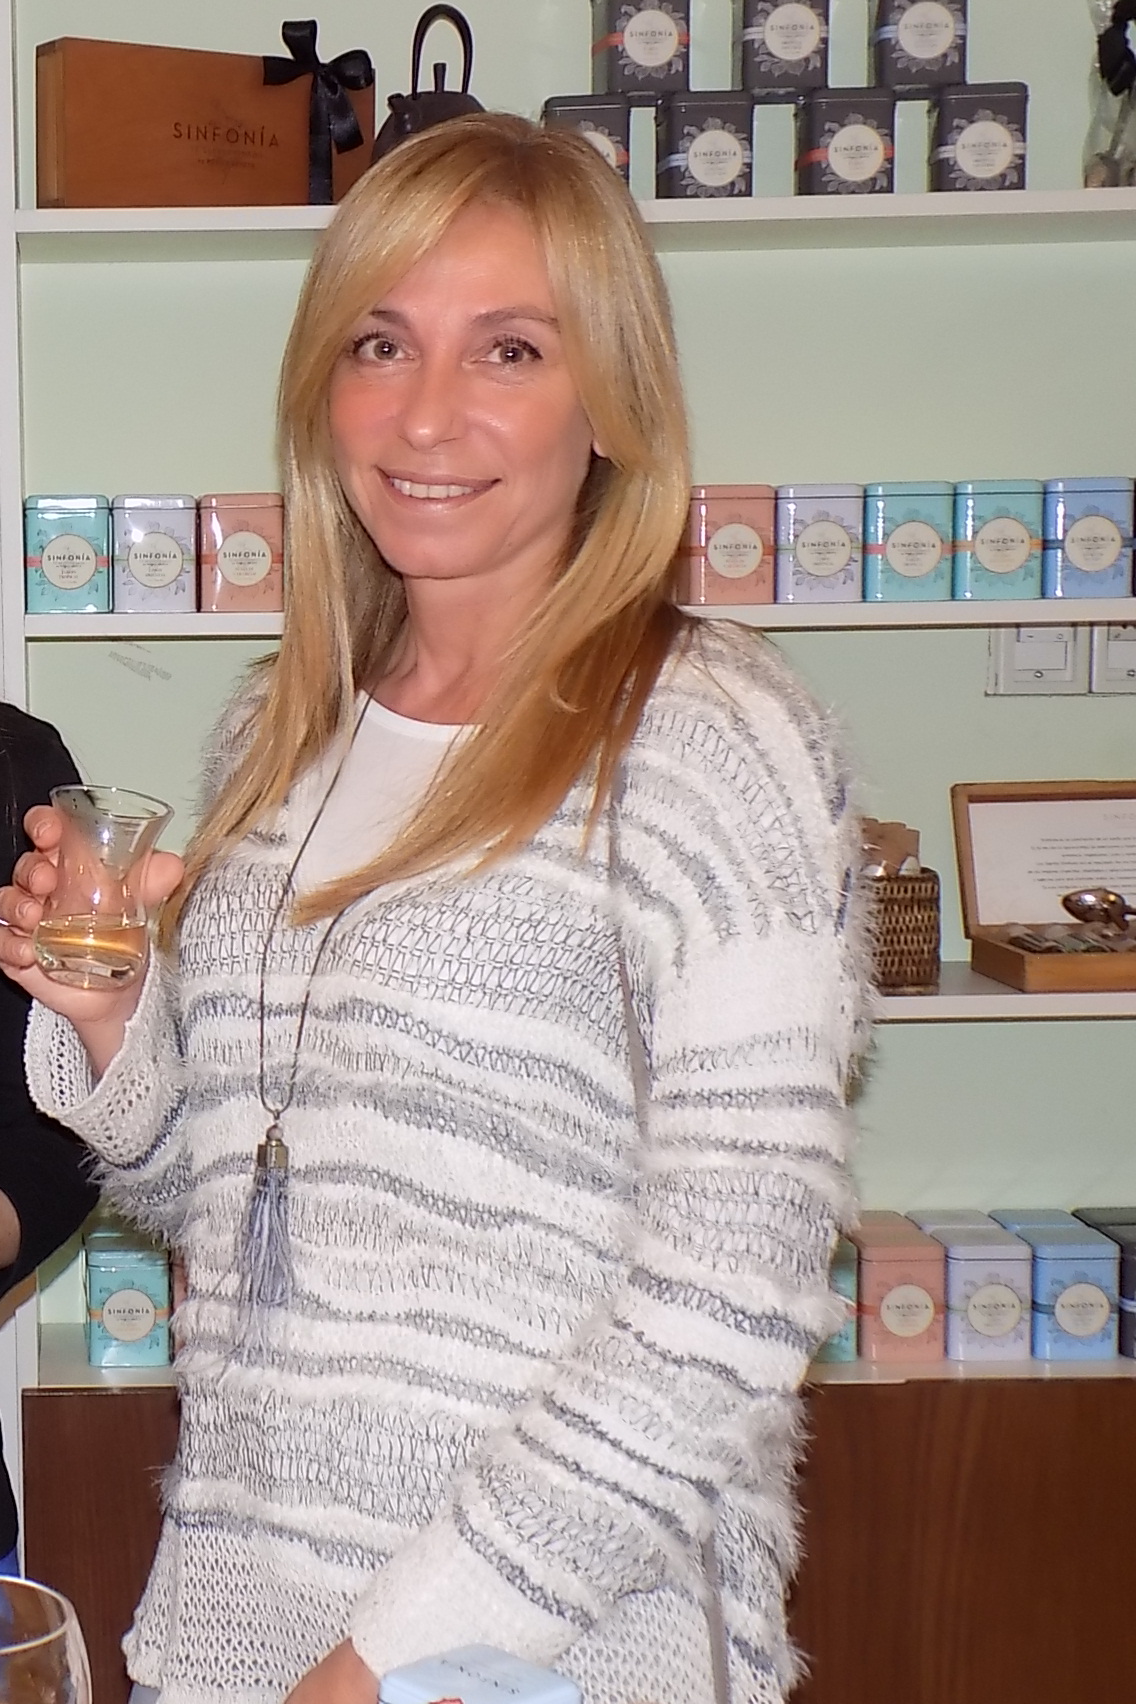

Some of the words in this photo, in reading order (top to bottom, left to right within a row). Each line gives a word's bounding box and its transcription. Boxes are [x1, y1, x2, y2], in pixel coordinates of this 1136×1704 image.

[172, 121, 279, 148] SINFONÍA
[47, 552, 91, 561] SINFONÍA
[133, 550, 177, 560] SINFONÍA
[223, 549, 267, 559] SINFONÍA
